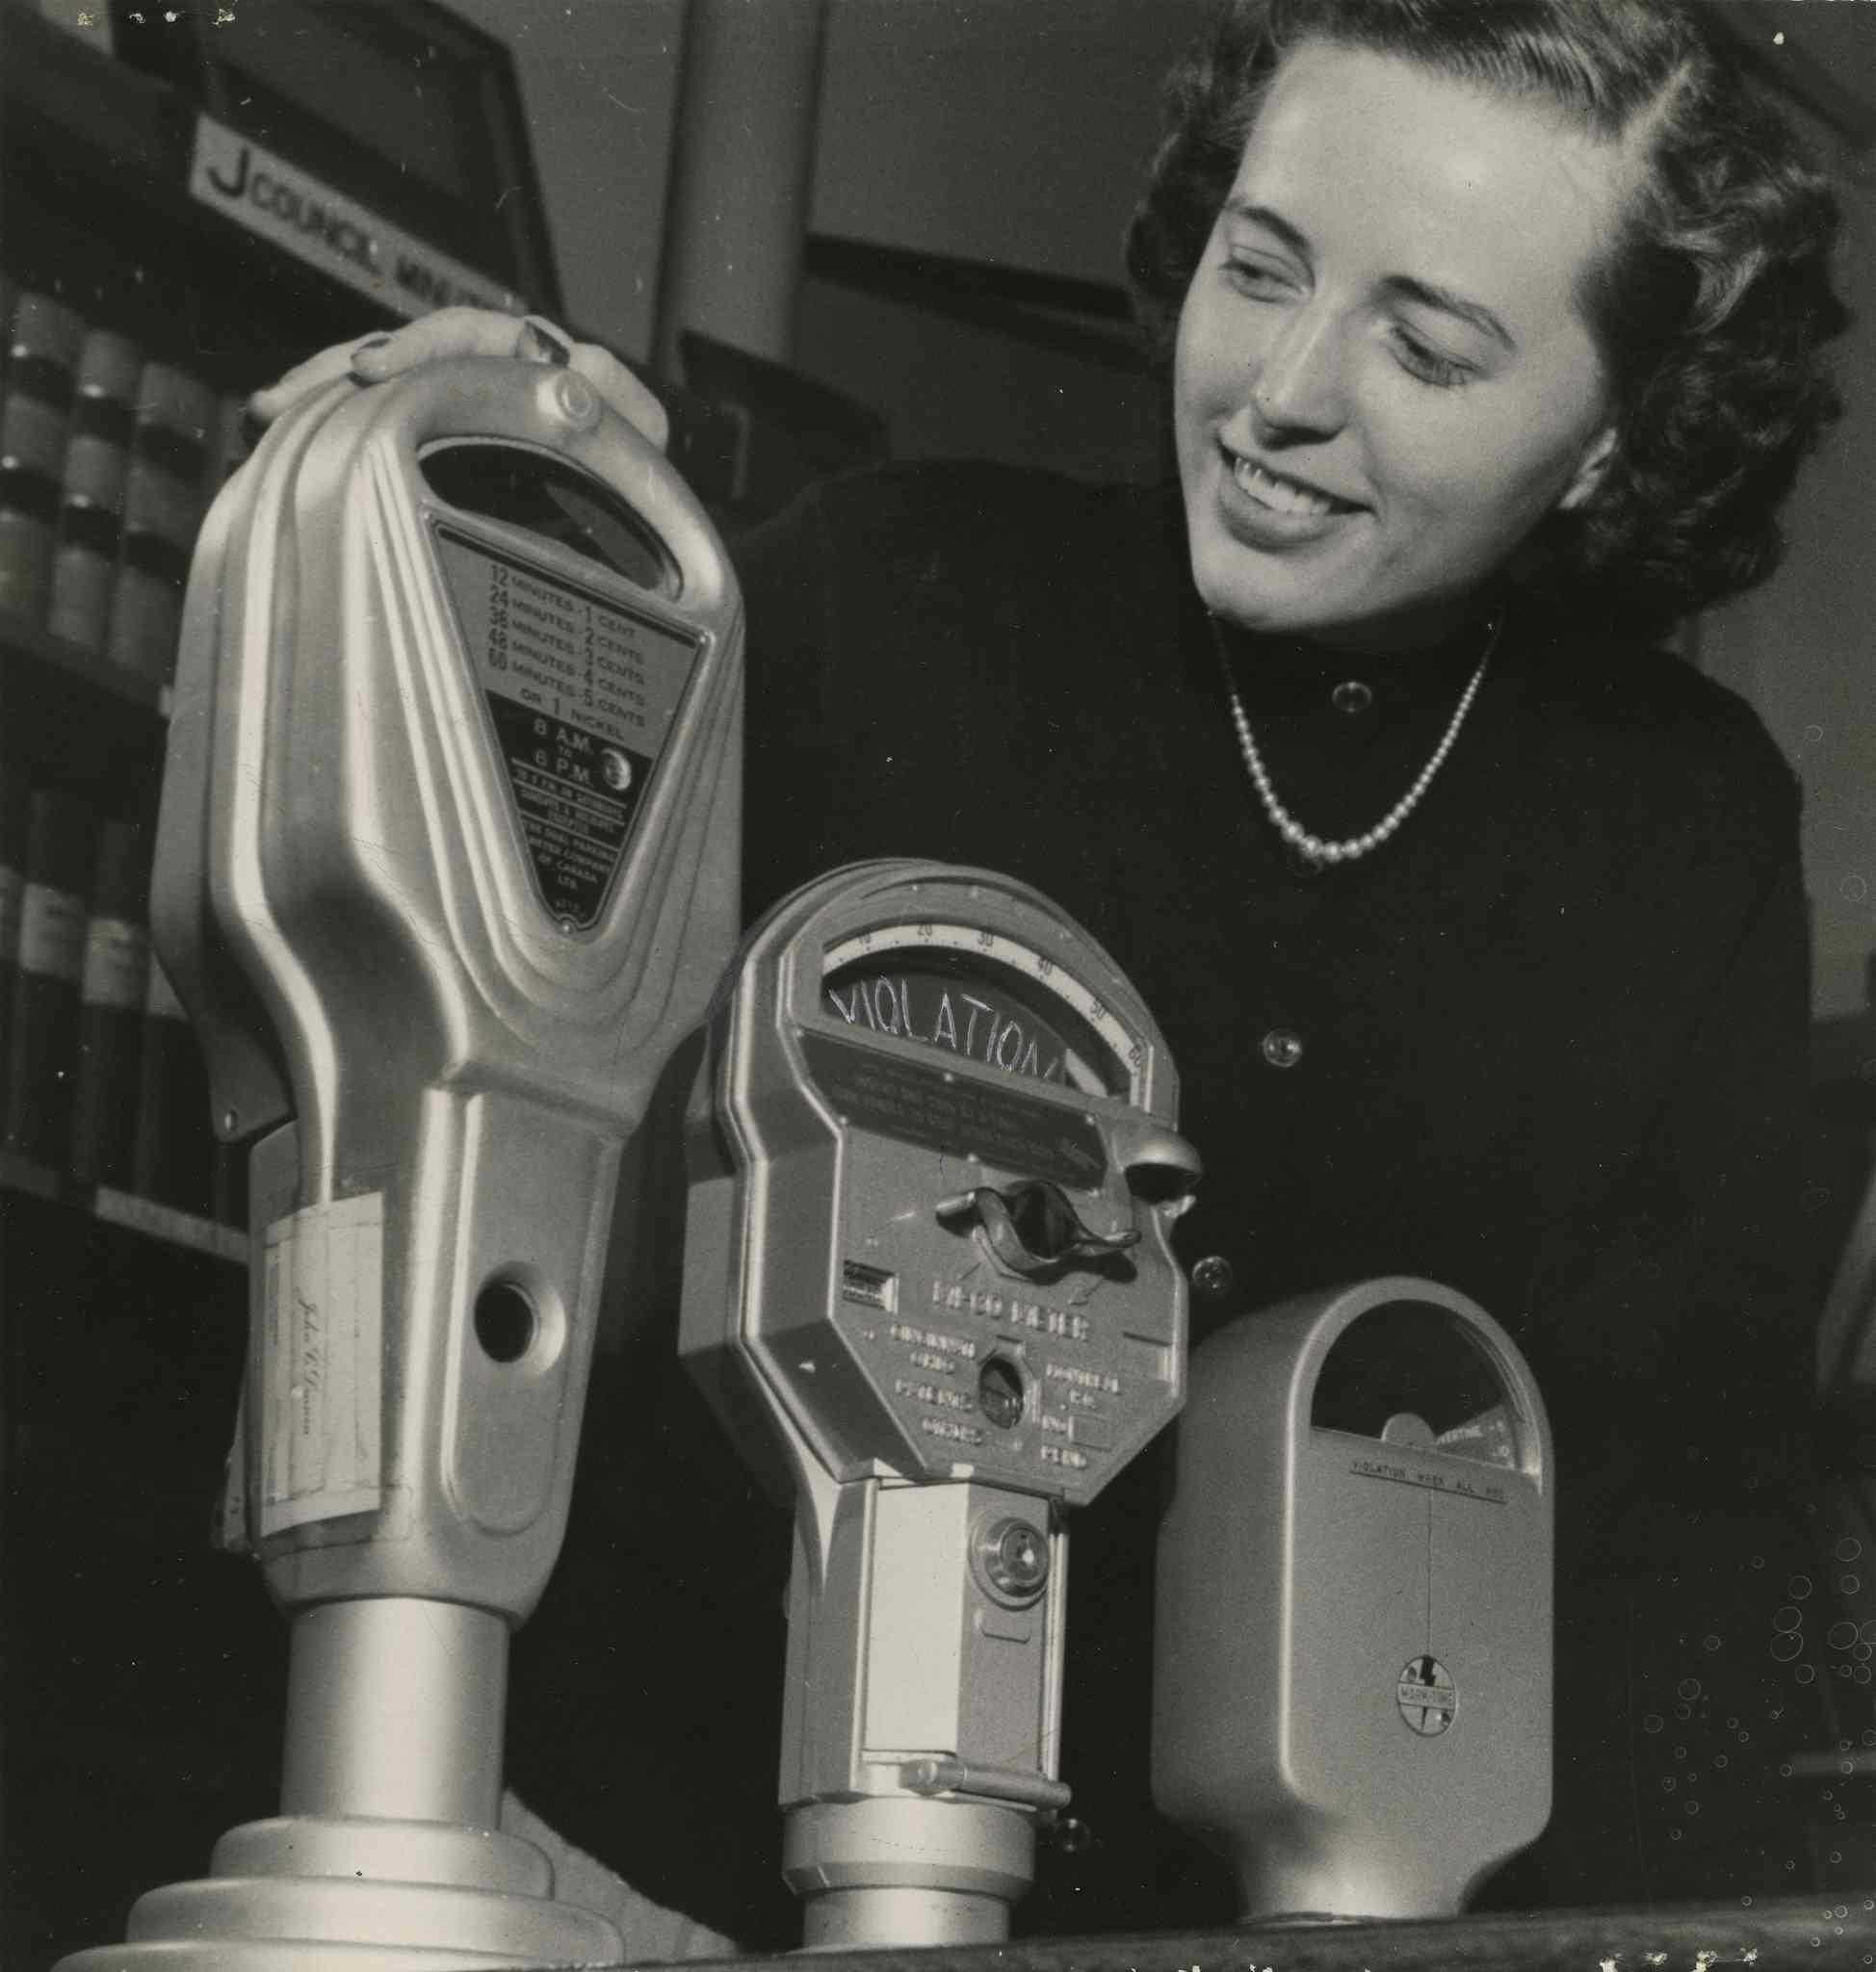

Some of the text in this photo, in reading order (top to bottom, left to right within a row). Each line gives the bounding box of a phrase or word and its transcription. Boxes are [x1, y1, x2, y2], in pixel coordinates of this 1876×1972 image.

[206, 147, 248, 198] J
[248, 176, 382, 274] COUNCIL
[511, 577, 574, 611] MINUTES
[585, 606, 592, 623] 1
[598, 616, 636, 638] CENT
[511, 599, 574, 634] MINUTES
[585, 627, 594, 646] 2
[597, 636, 644, 665] CENTS
[511, 620, 574, 655] MINUTES
[585, 647, 594, 666] 3
[597, 657, 644, 686] CENTS
[511, 640, 575, 676] MINUTES
[584, 668, 593, 687] 4
[597, 678, 645, 707] CENTS
[511, 662, 576, 697] MINUTES
[584, 688, 593, 708] 5
[597, 699, 645, 727] CENTS
[520, 688, 625, 740] OR 1 NICKEL
[534, 718, 548, 736] 8
[857, 923, 1142, 1068] 10 20 30 40 50 60
[1351, 1459, 1407, 1479] VIOLATION
